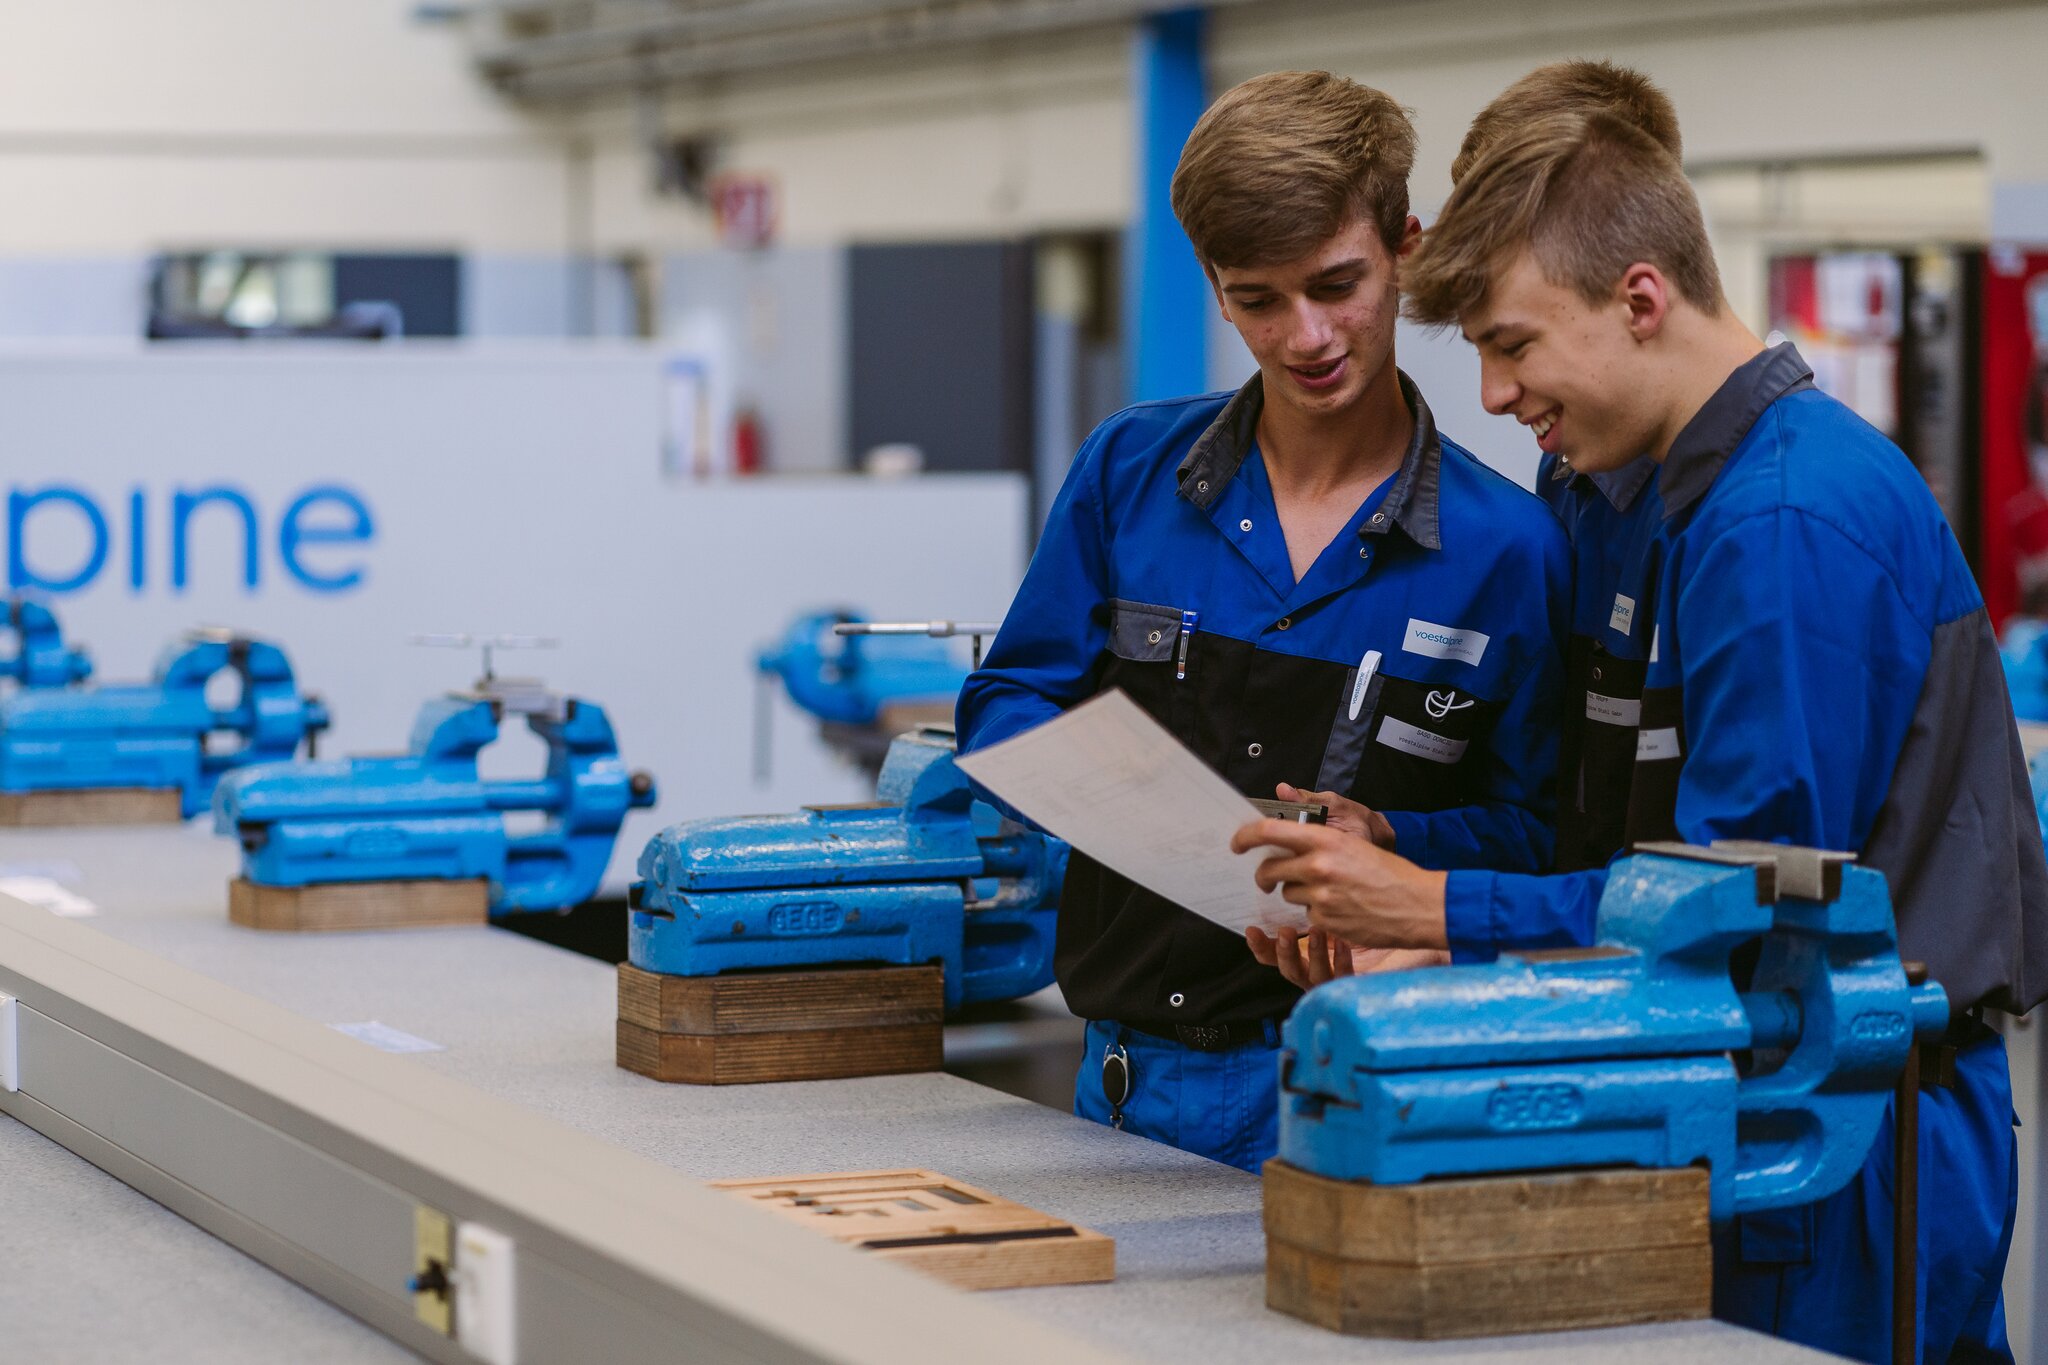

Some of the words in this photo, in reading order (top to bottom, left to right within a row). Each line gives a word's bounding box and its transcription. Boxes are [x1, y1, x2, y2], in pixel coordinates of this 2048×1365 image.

[8, 485, 374, 593] pine
[1415, 630, 1463, 647] voestalpine
[1352, 671, 1365, 705] voestalpine
